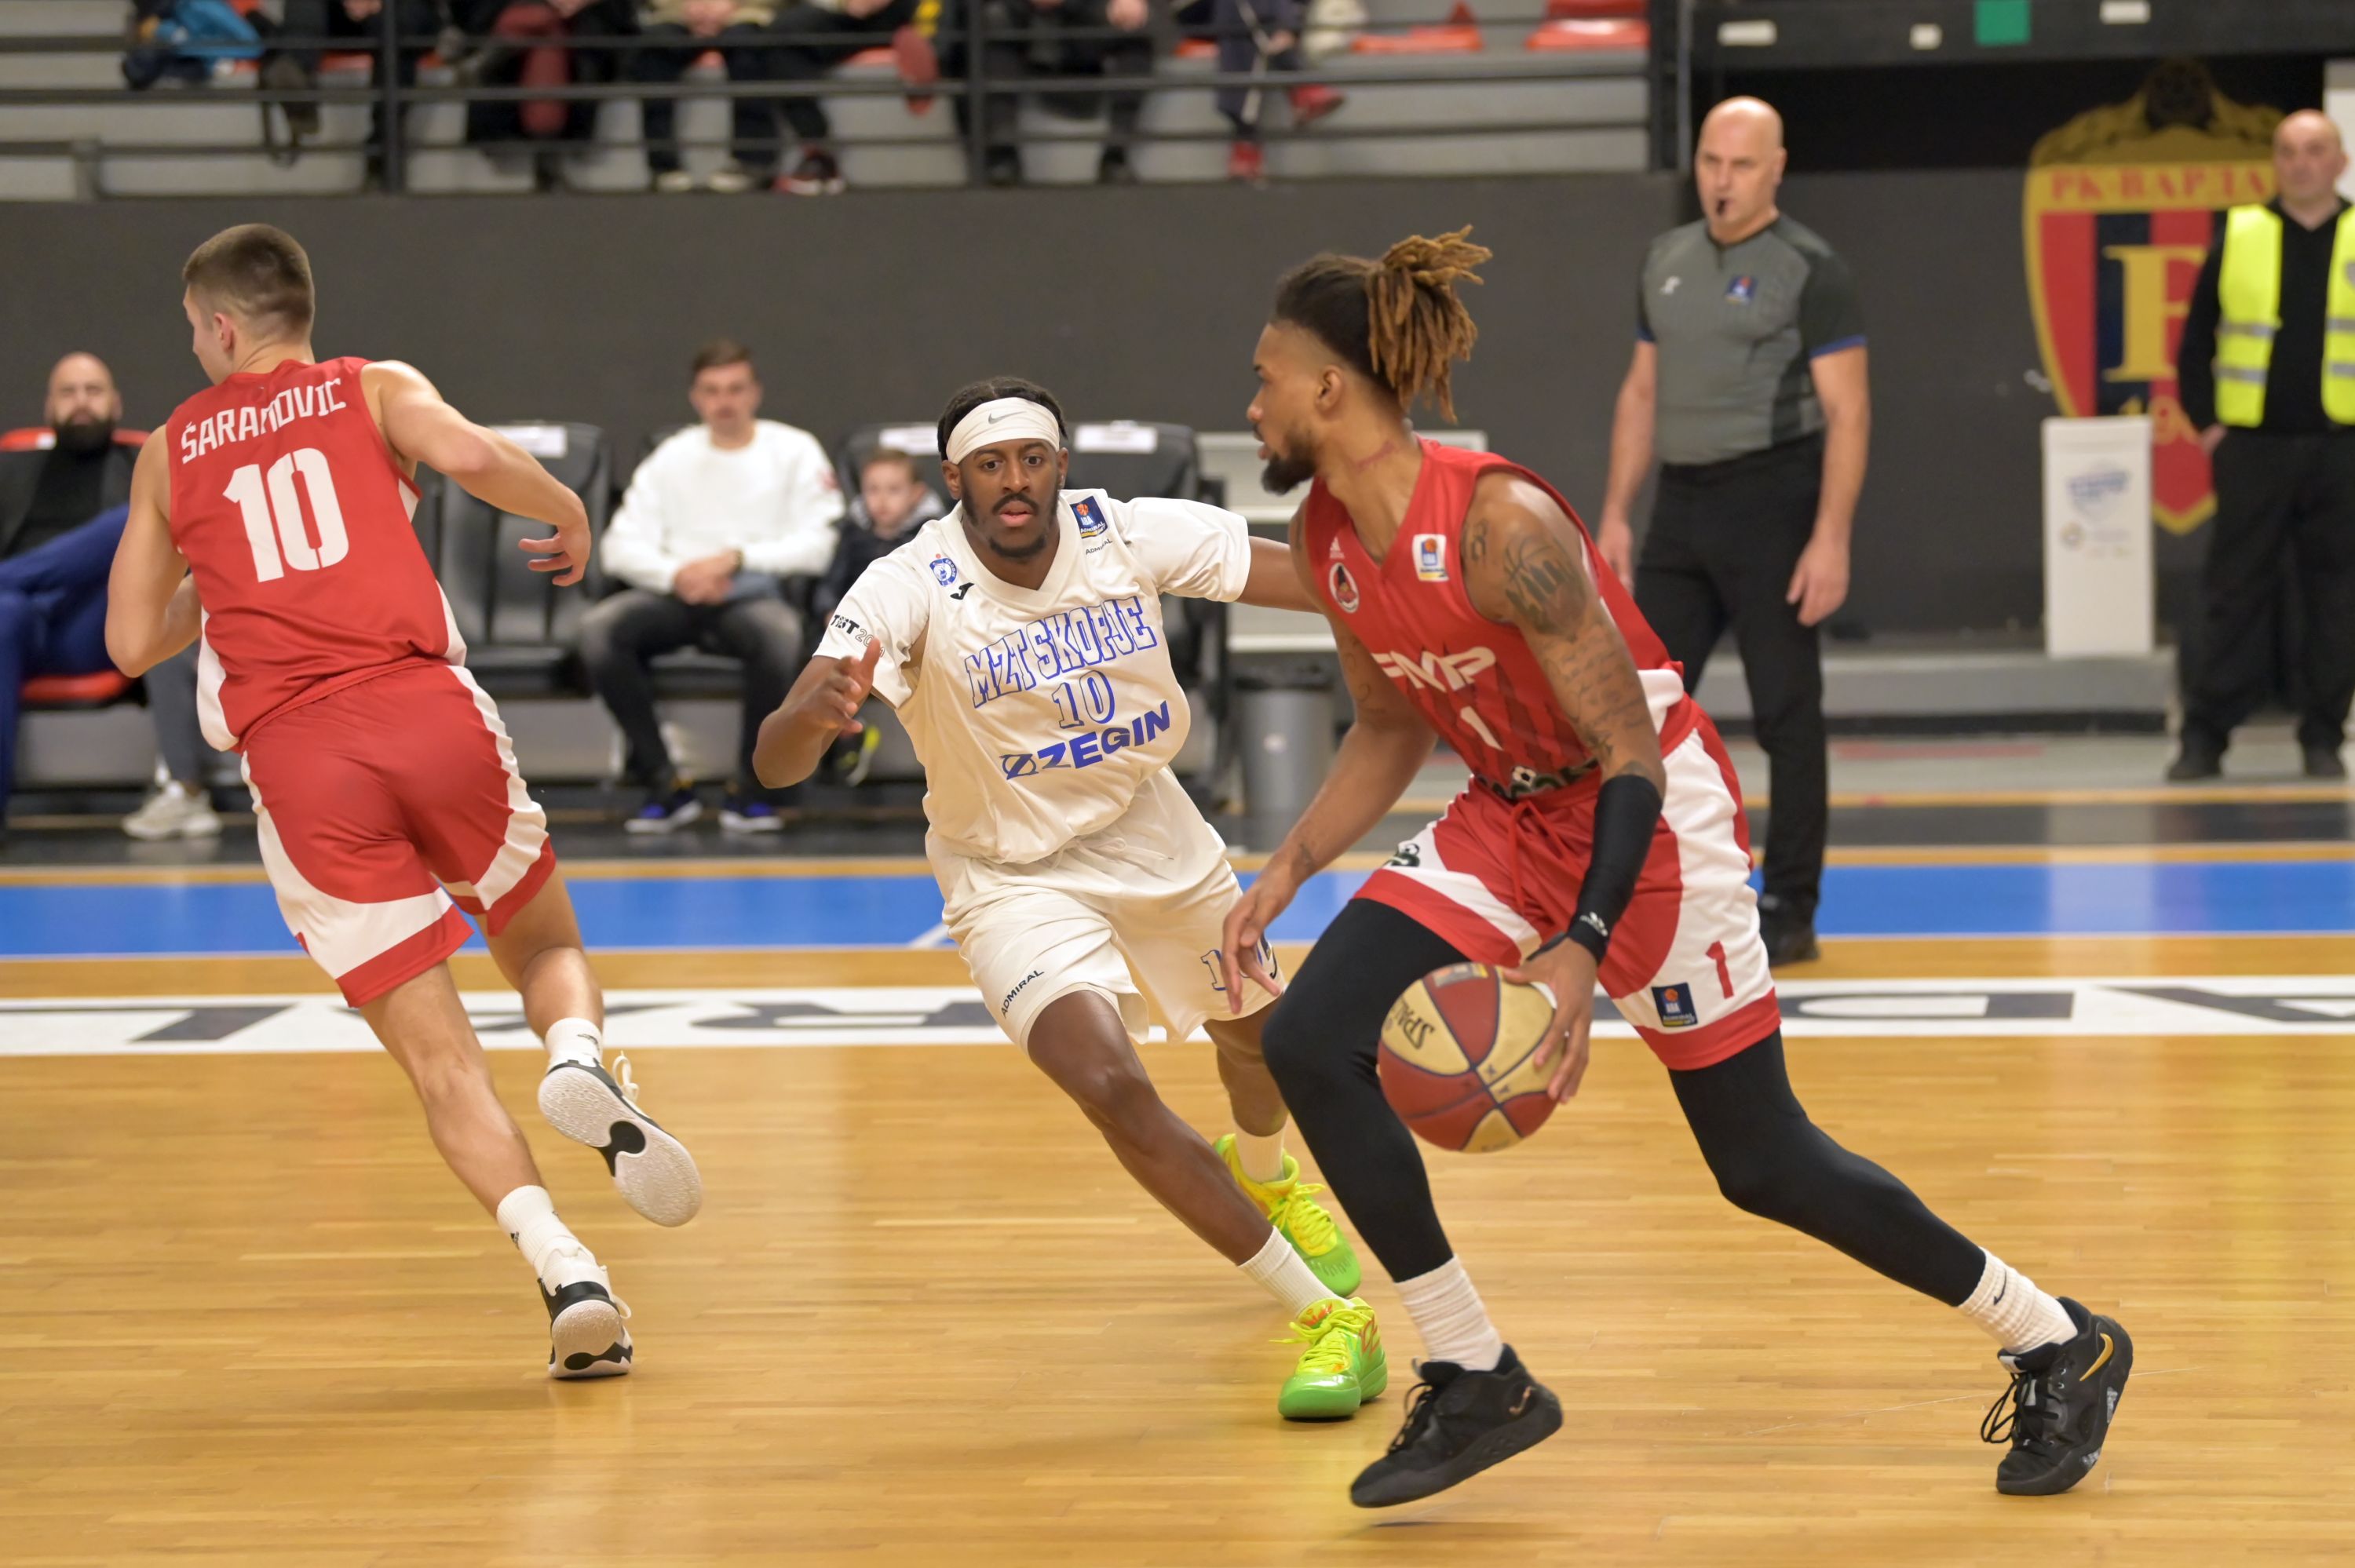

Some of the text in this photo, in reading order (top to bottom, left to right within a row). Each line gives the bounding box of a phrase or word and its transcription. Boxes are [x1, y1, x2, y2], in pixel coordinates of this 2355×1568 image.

[222, 447, 349, 583] 10
[965, 596, 1157, 708] MZT SKOPJE
[1051, 669, 1123, 729] 10
[1037, 701, 1170, 769] ZEGIN
[1001, 970, 1045, 1019] ADMIRAL
[1706, 940, 1734, 1000] 1
